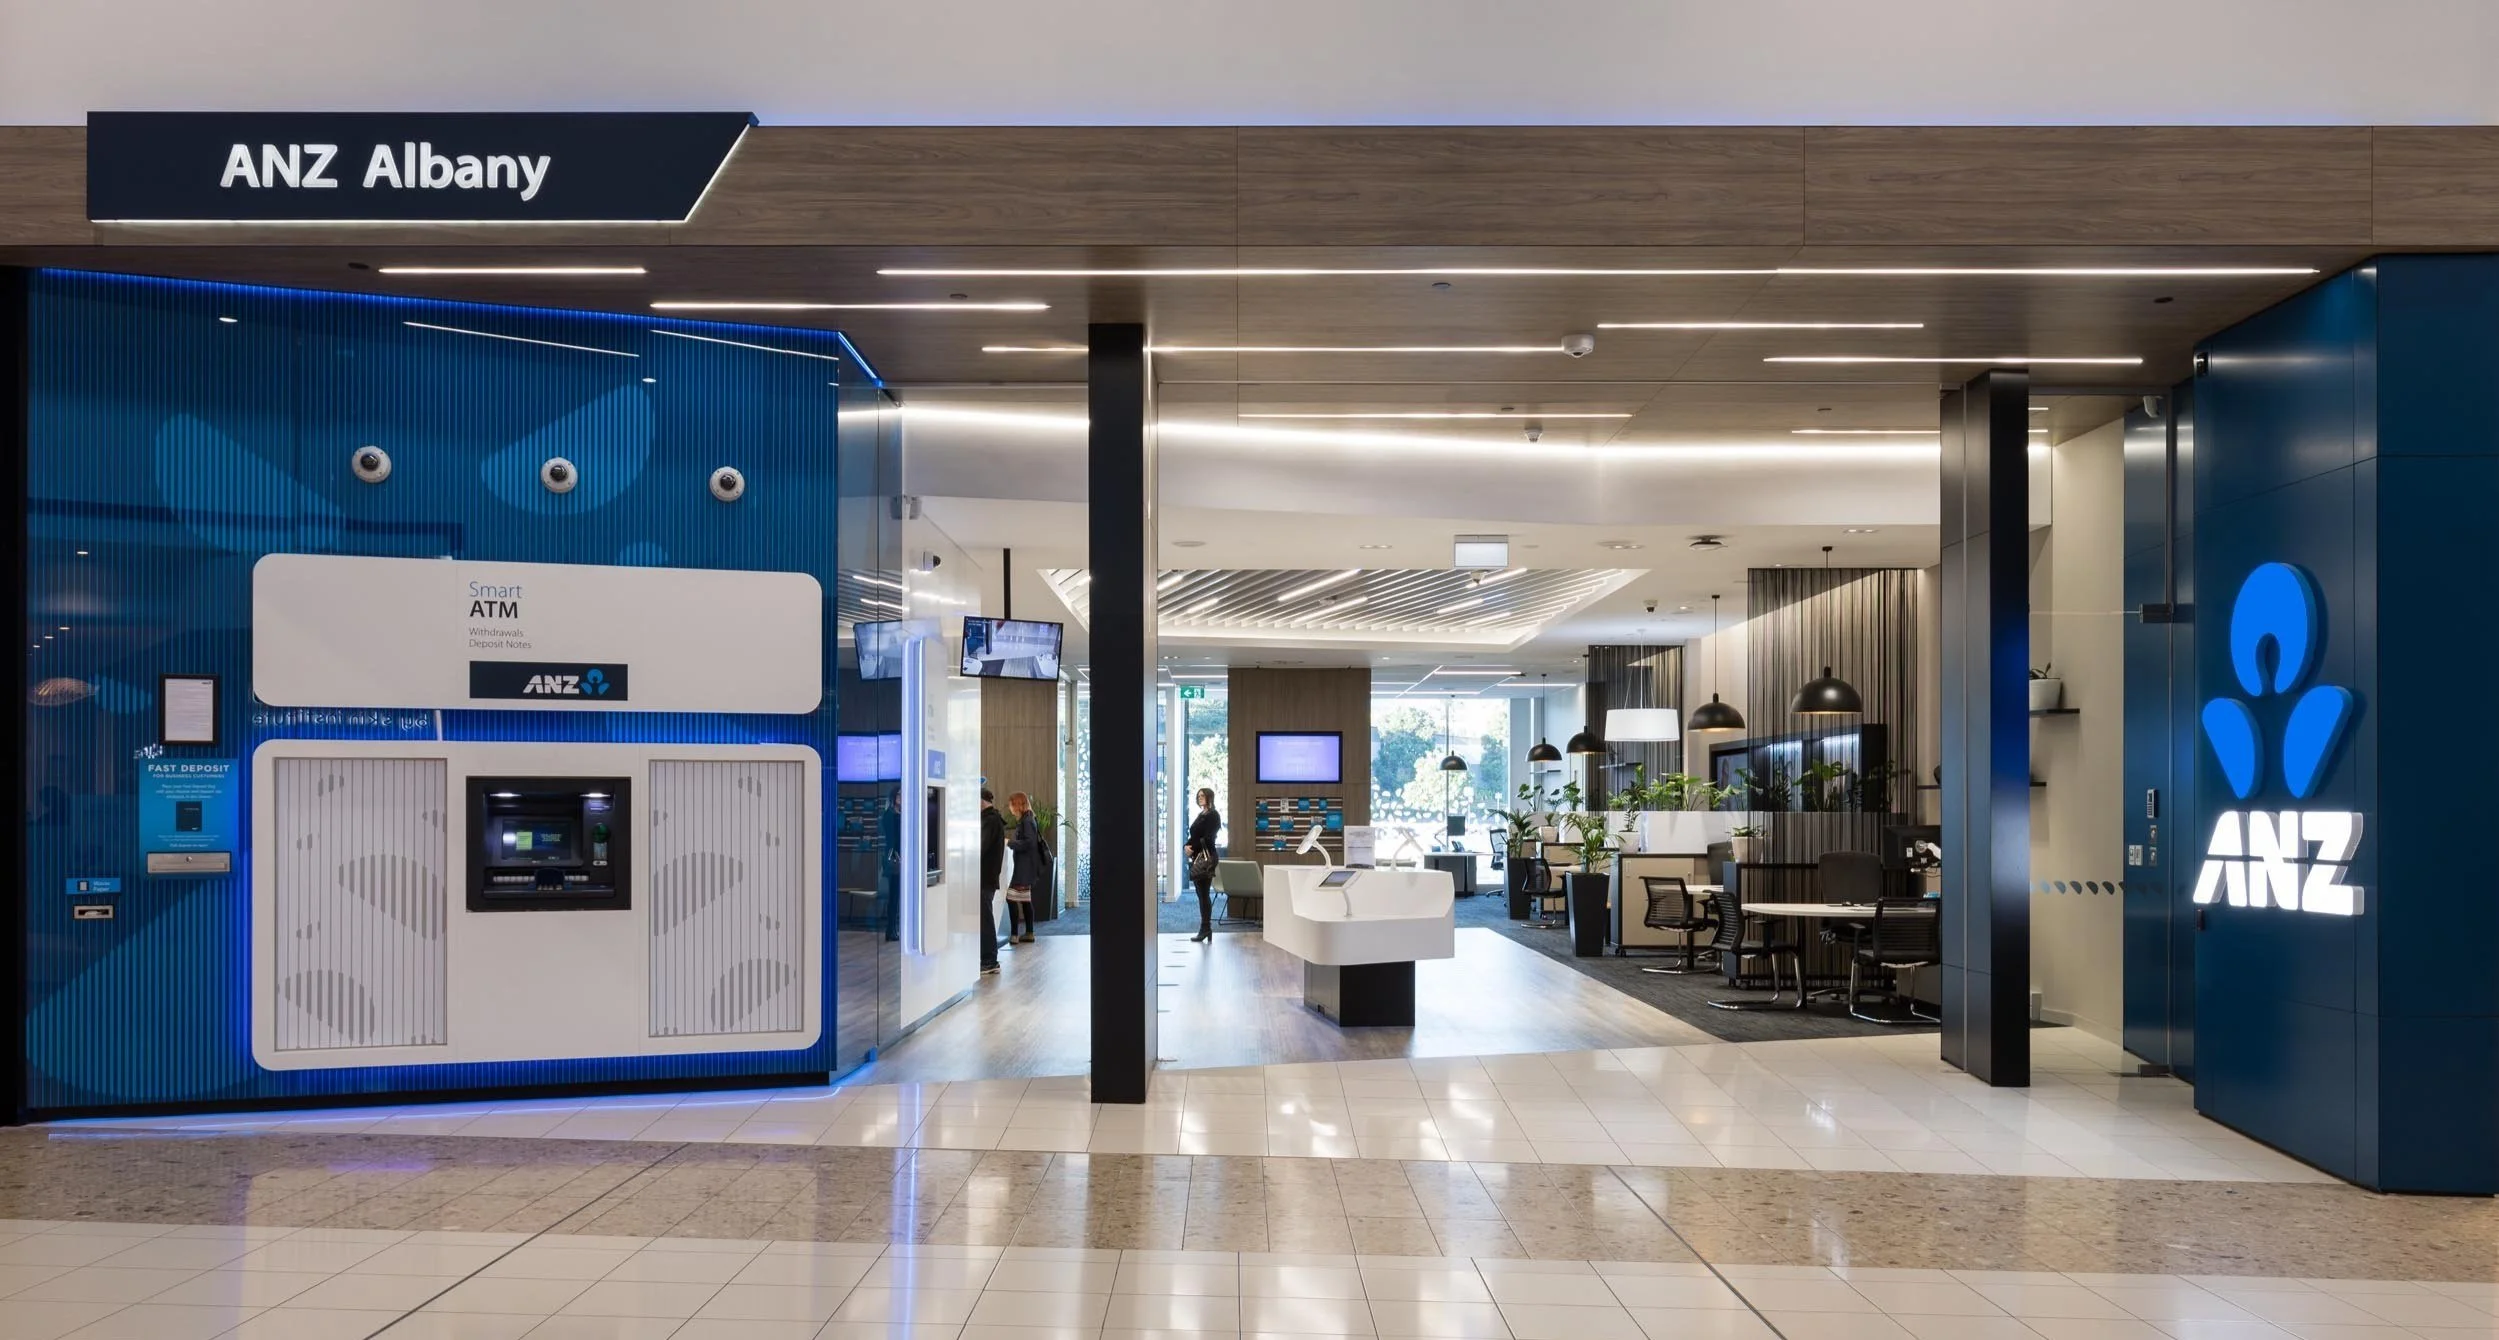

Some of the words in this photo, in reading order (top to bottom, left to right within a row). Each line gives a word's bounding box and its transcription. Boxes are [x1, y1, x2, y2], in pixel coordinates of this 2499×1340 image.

[220, 143, 338, 188] ANZ
[362, 142, 551, 201] Albany
[469, 581, 523, 599] Smart
[469, 600, 519, 619] ATM
[469, 627, 524, 638] Withdrawals
[469, 639, 503, 649] Deposit
[506, 640, 532, 649] Notes
[523, 675, 580, 694] ANZ
[148, 764, 177, 773] FAST
[181, 764, 230, 773] DEPOSIT
[2192, 810, 2364, 916] ANZ
